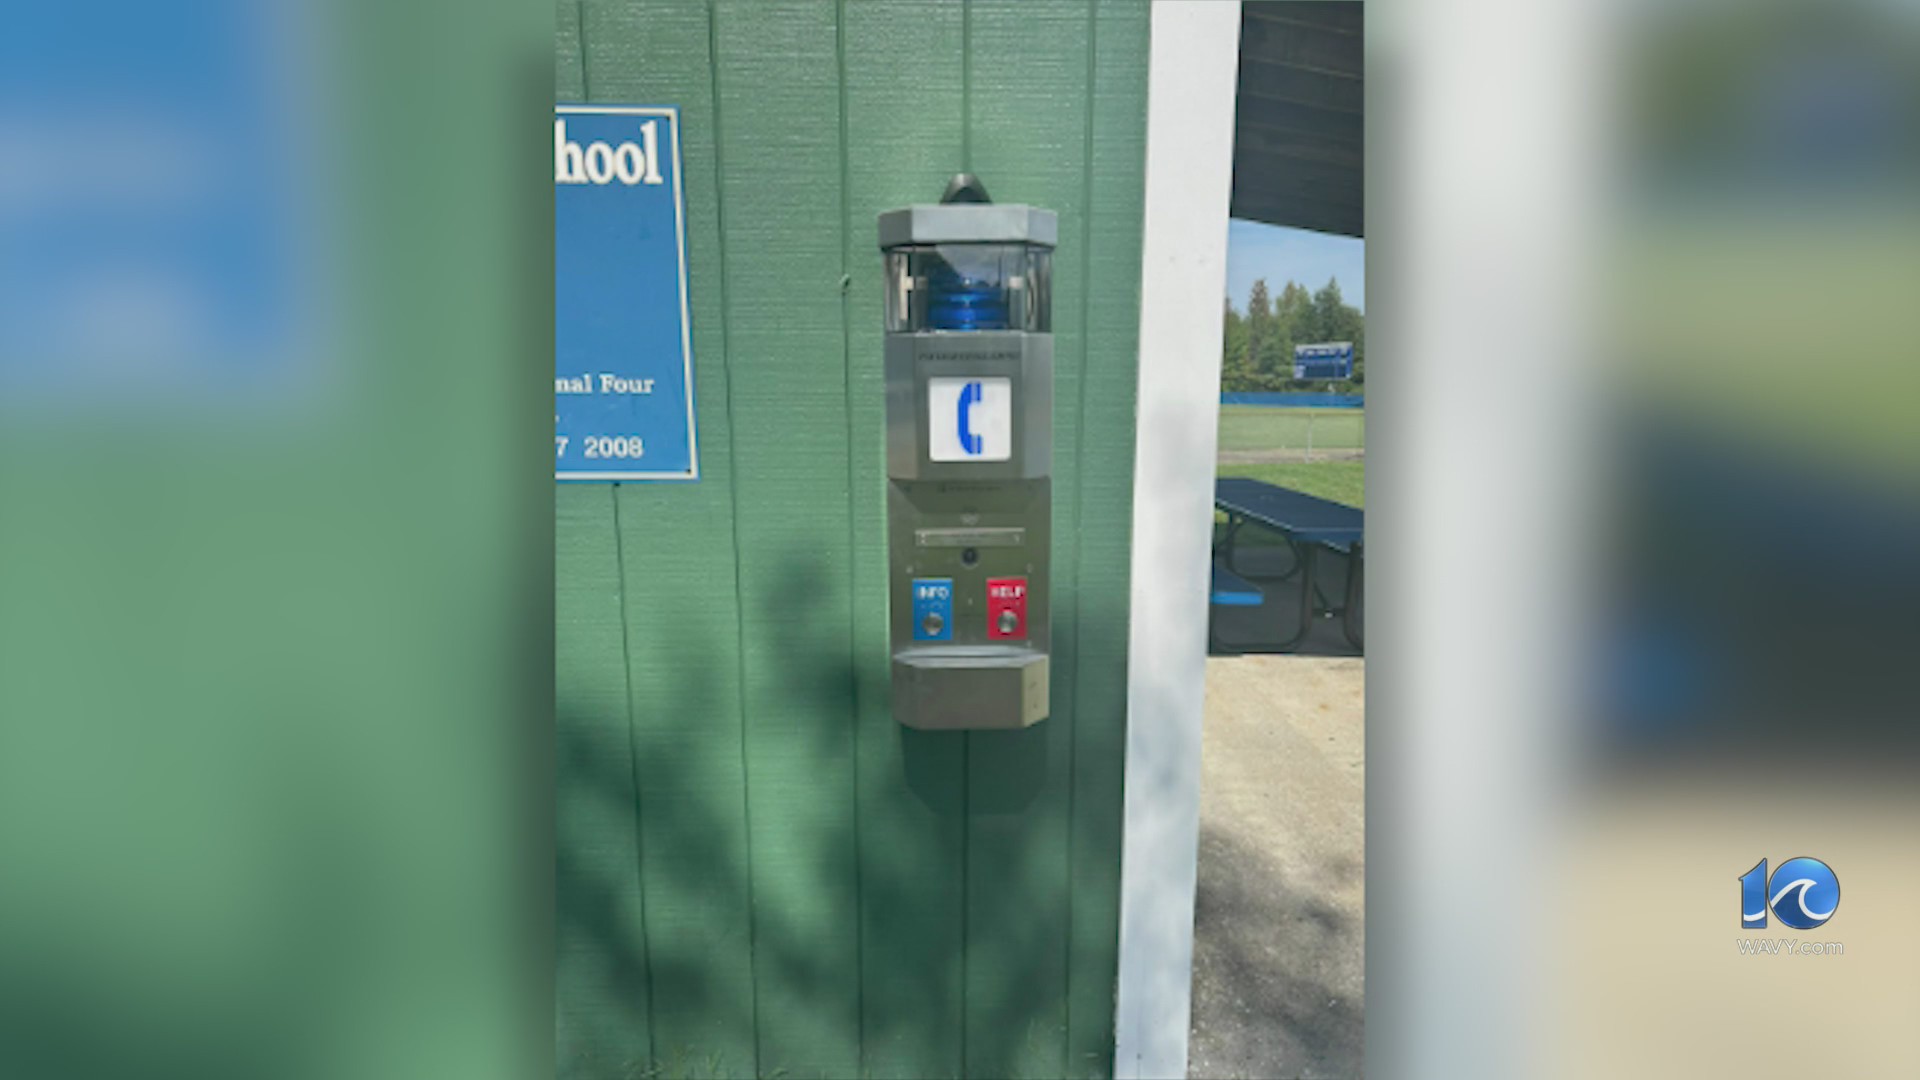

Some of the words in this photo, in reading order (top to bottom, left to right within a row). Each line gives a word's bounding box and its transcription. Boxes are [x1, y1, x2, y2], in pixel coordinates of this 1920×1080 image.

[555, 118, 663, 184] hool
[599, 374, 655, 394] Four
[584, 436, 644, 459] 2008
[991, 585, 1025, 598] HELP
